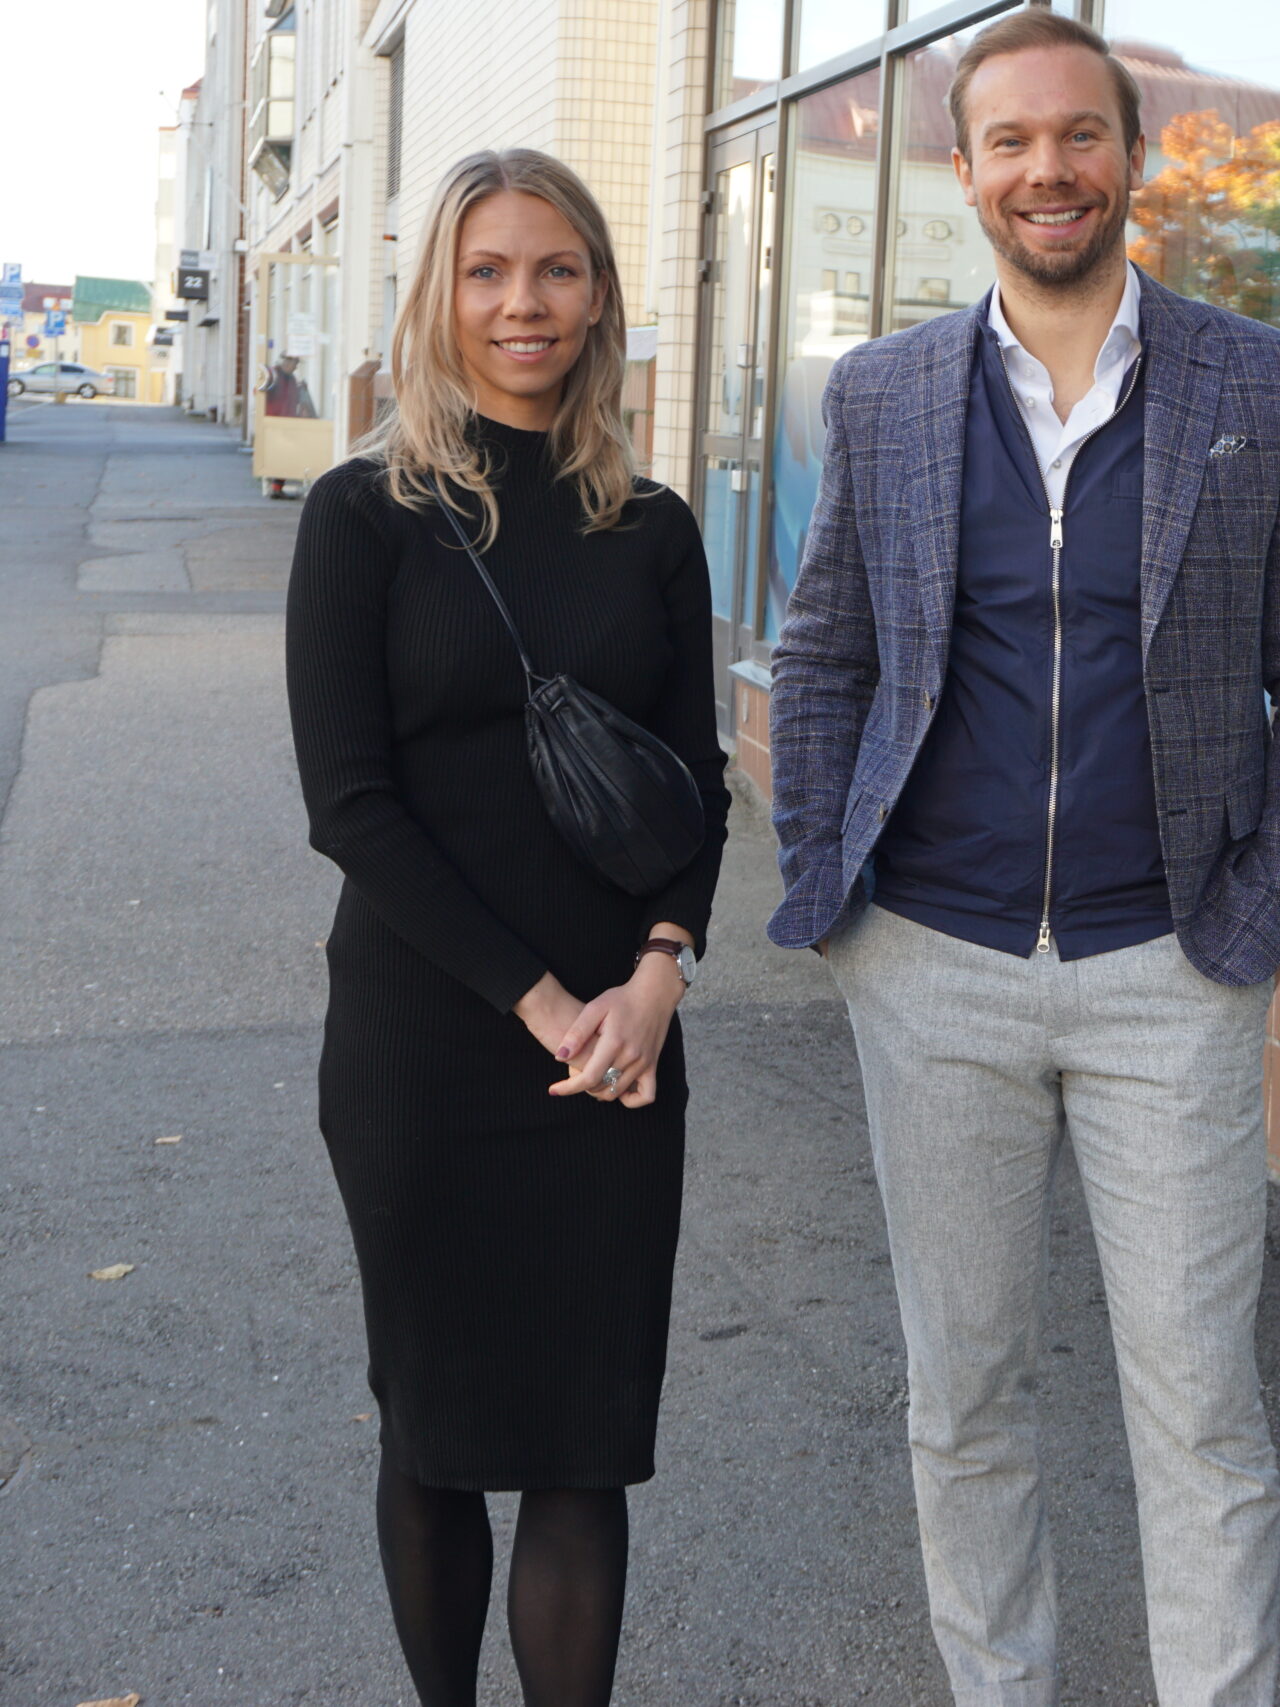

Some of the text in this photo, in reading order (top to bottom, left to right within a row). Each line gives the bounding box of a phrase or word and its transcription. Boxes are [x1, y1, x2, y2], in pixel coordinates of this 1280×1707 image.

[5, 264, 20, 282] P
[184, 276, 203, 288] 22
[50, 311, 63, 328] P
